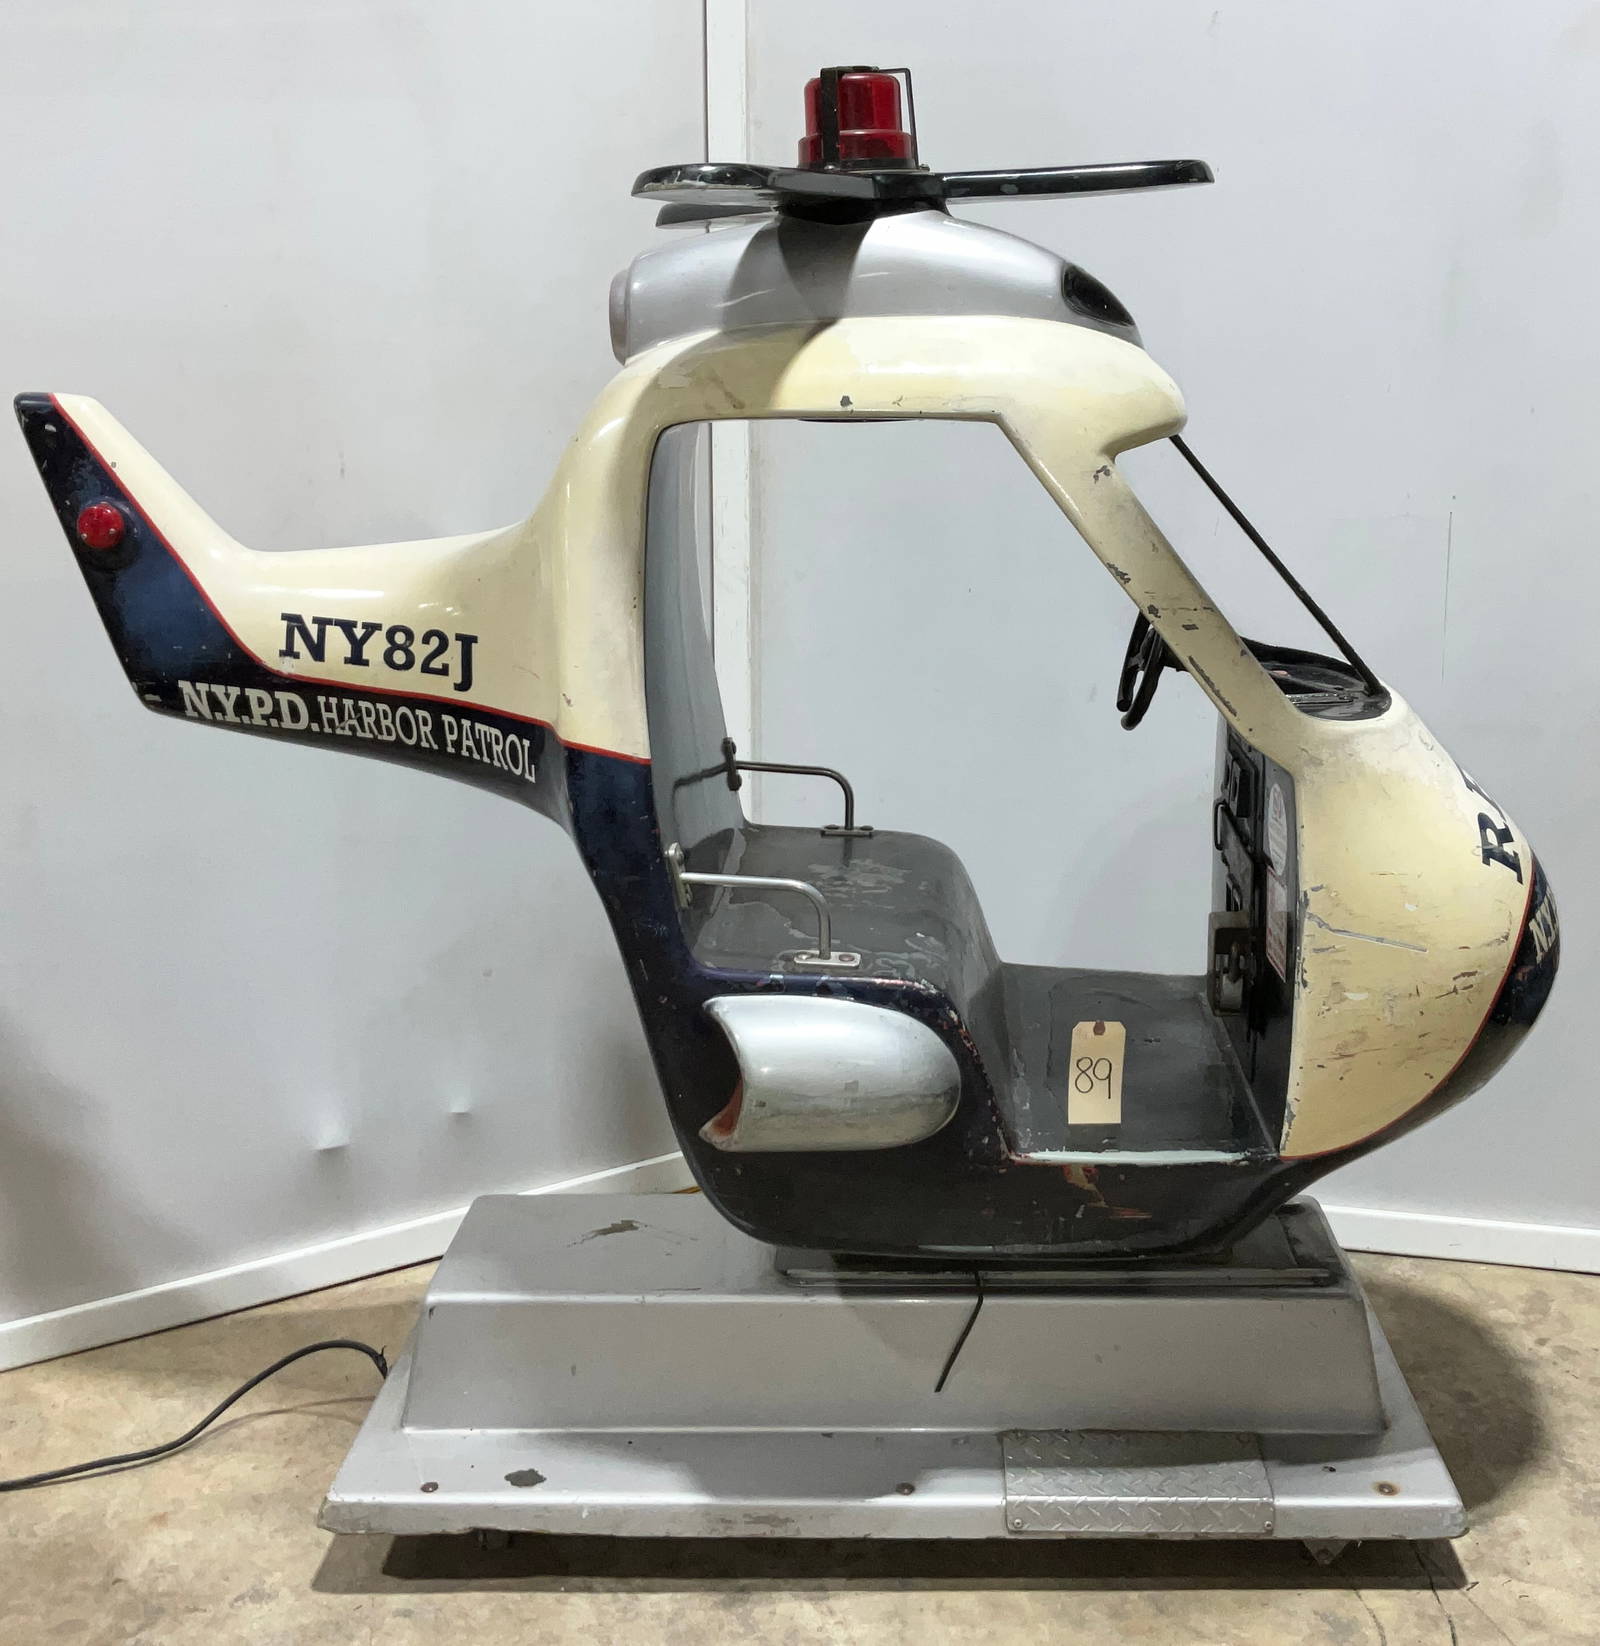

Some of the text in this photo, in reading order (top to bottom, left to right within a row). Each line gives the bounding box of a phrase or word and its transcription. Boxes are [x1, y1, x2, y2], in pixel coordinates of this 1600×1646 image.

[278, 612, 479, 692] NY82J
[178, 679, 536, 783] N.Y.P.D. HARBOR PATROL
[1075, 1056, 1113, 1100] 89
